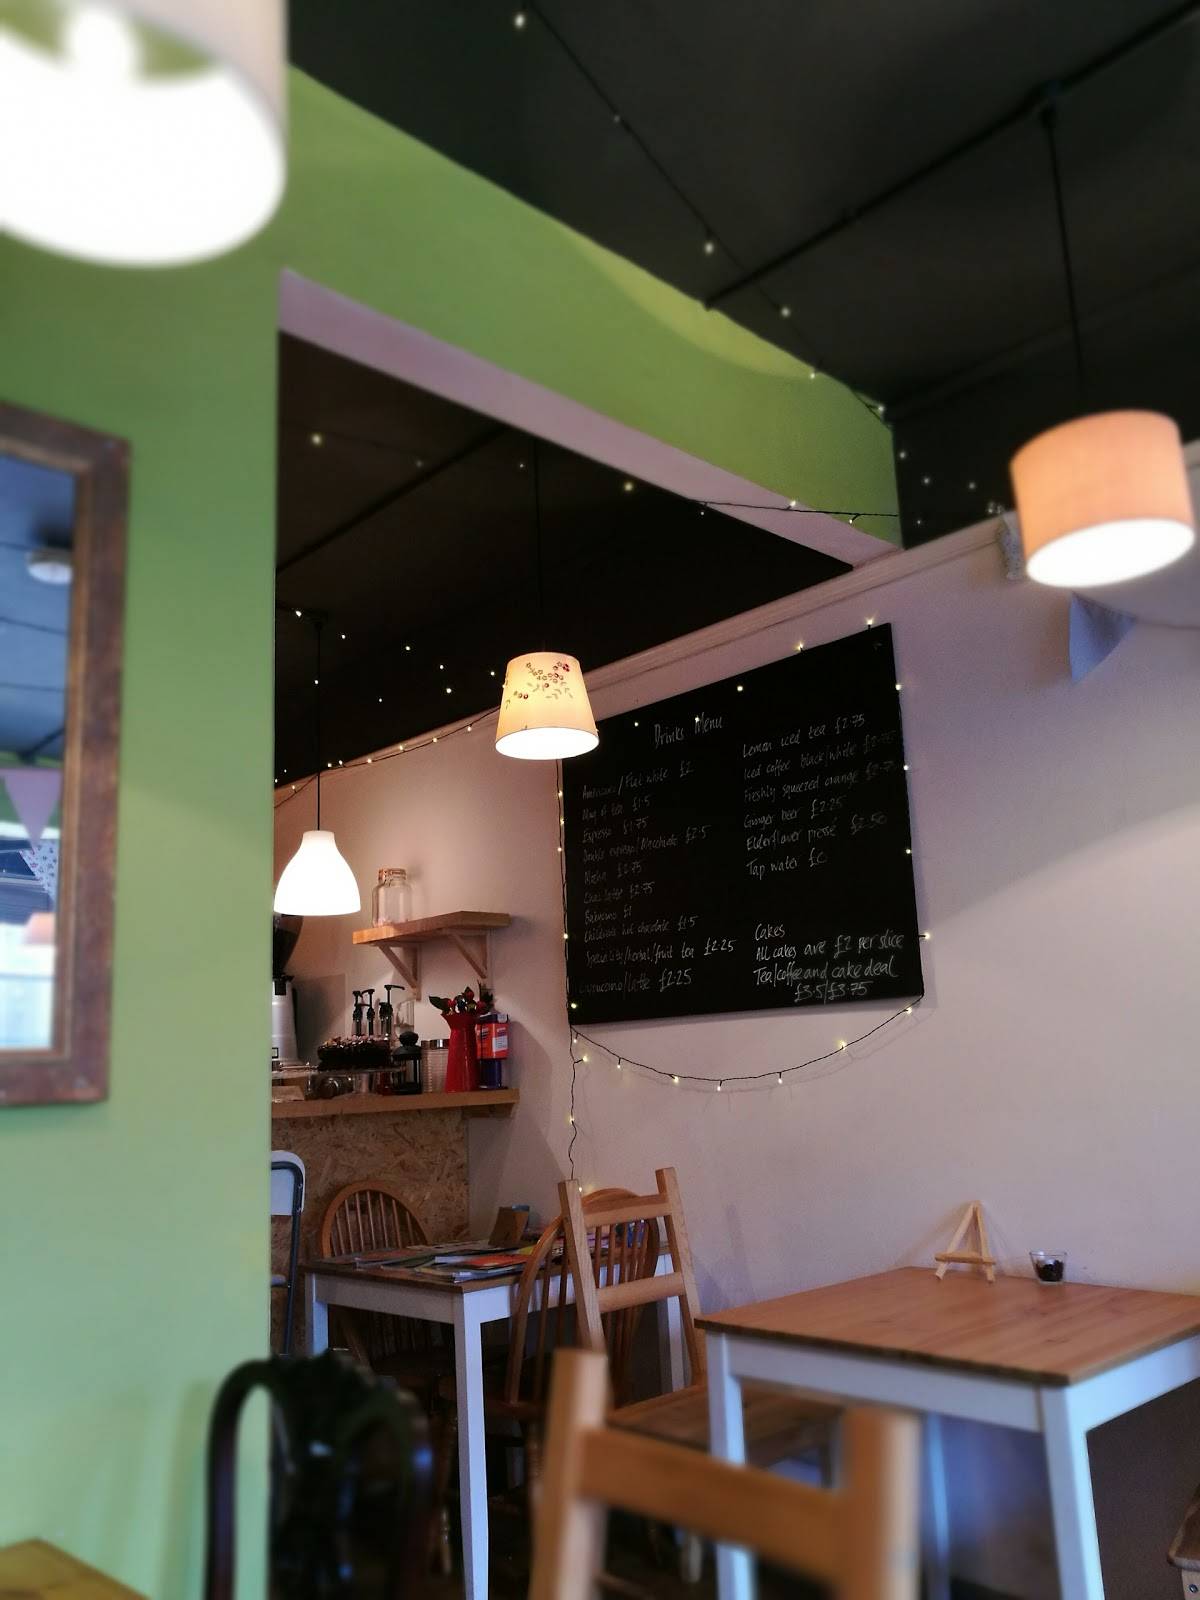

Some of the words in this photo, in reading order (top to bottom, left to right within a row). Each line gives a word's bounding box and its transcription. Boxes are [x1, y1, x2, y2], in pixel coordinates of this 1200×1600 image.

[653, 723, 685, 749] Drinks
[694, 712, 723, 735] Menu
[743, 743, 772, 758] Lemon
[781, 730, 800, 746] iced
[808, 725, 825, 739] tea
[745, 765, 761, 780] Iced
[766, 760, 791, 777] coffee
[744, 783, 775, 802] Freshly
[824, 771, 858, 790] orange
[744, 814, 772, 829] Ginger
[781, 808, 800, 821] beer
[747, 830, 800, 851] Elderflower
[747, 859, 765, 879] Tap
[771, 855, 798, 870] water
[755, 924, 785, 941] Cakes
[682, 942, 694, 959] tea
[773, 946, 796, 958] cakes
[804, 941, 826, 955] are
[834, 935, 852, 959] £2
[858, 935, 876, 954] per
[880, 930, 904, 948] slice
[832, 961, 862, 978] cake
[865, 955, 899, 977] deal
